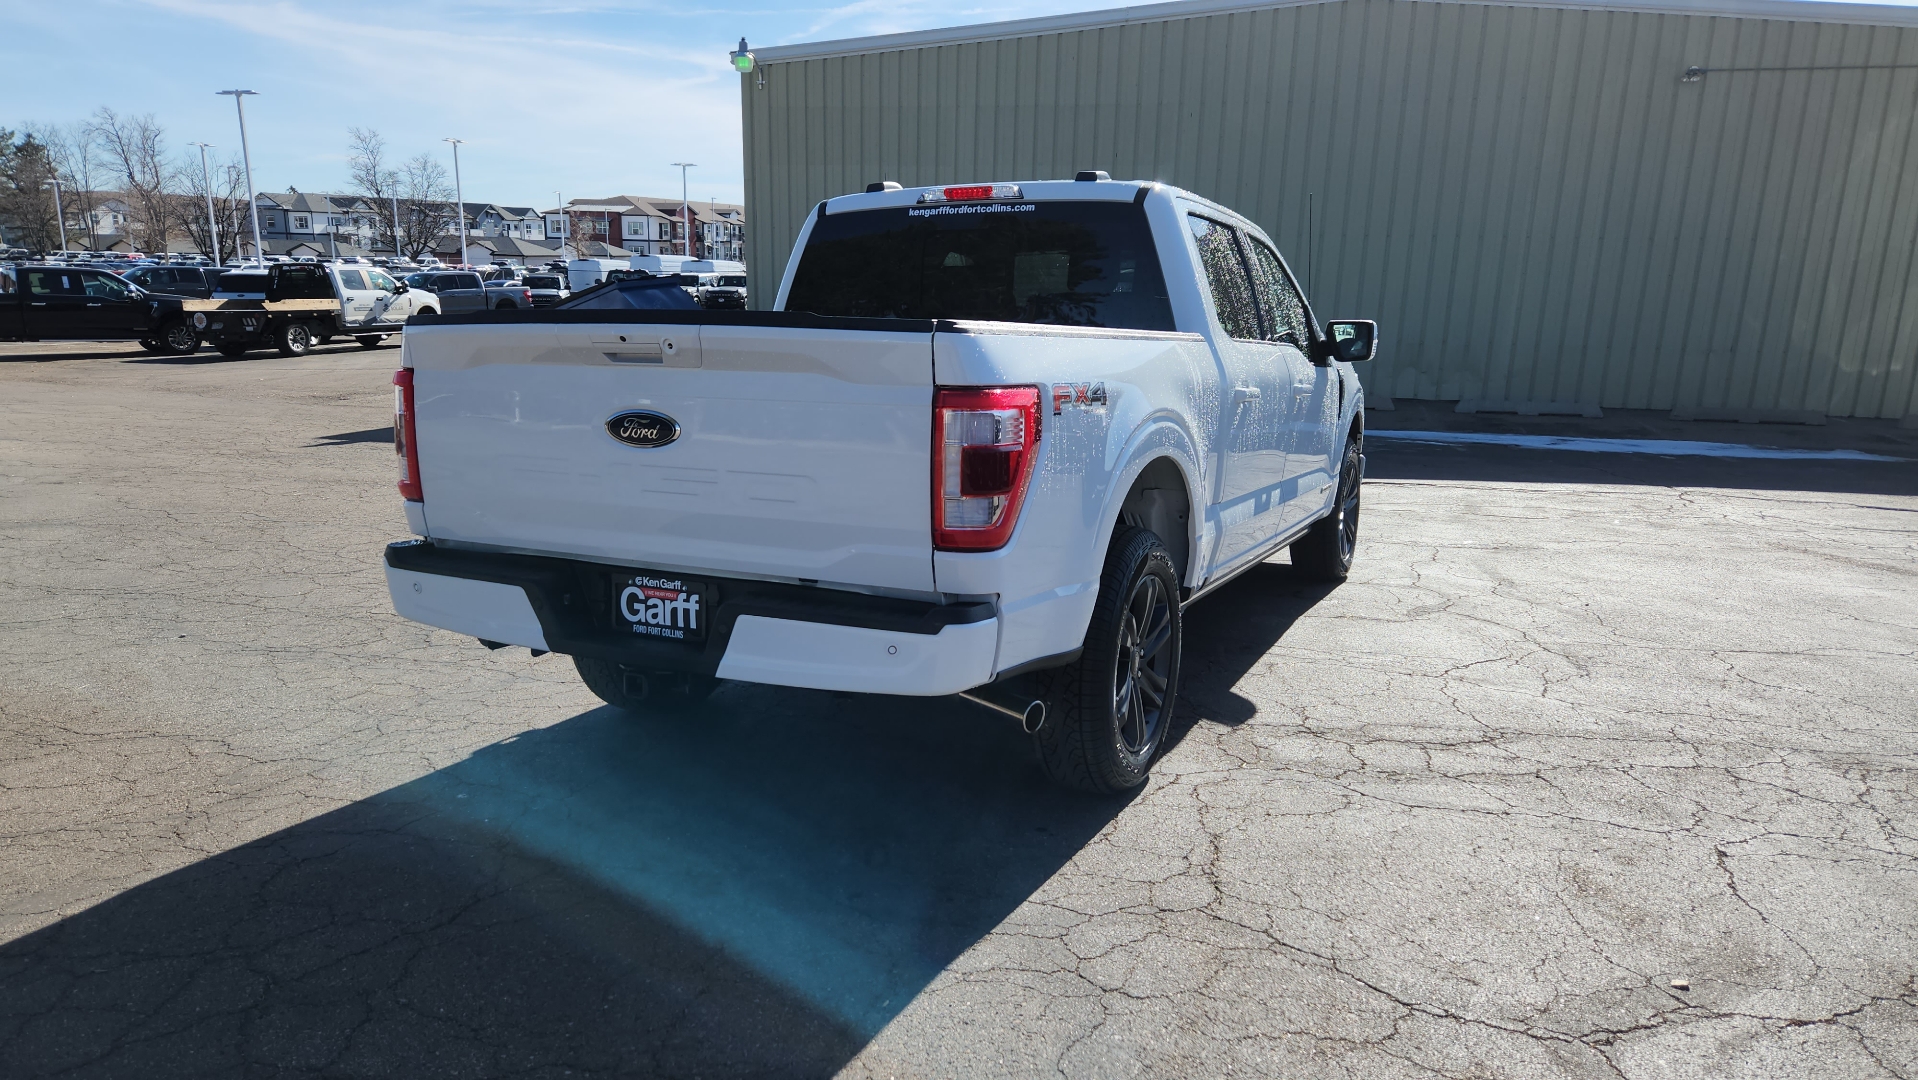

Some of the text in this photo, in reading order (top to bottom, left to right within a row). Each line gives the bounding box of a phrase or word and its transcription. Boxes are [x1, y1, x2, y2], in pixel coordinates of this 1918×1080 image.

[1051, 382, 1107, 416] FX4
[620, 417, 660, 439] Ford
[643, 576, 682, 591] Ken Garff
[620, 586, 700, 630] Garff
[633, 624, 684, 639] FORD FORT COLLINS
